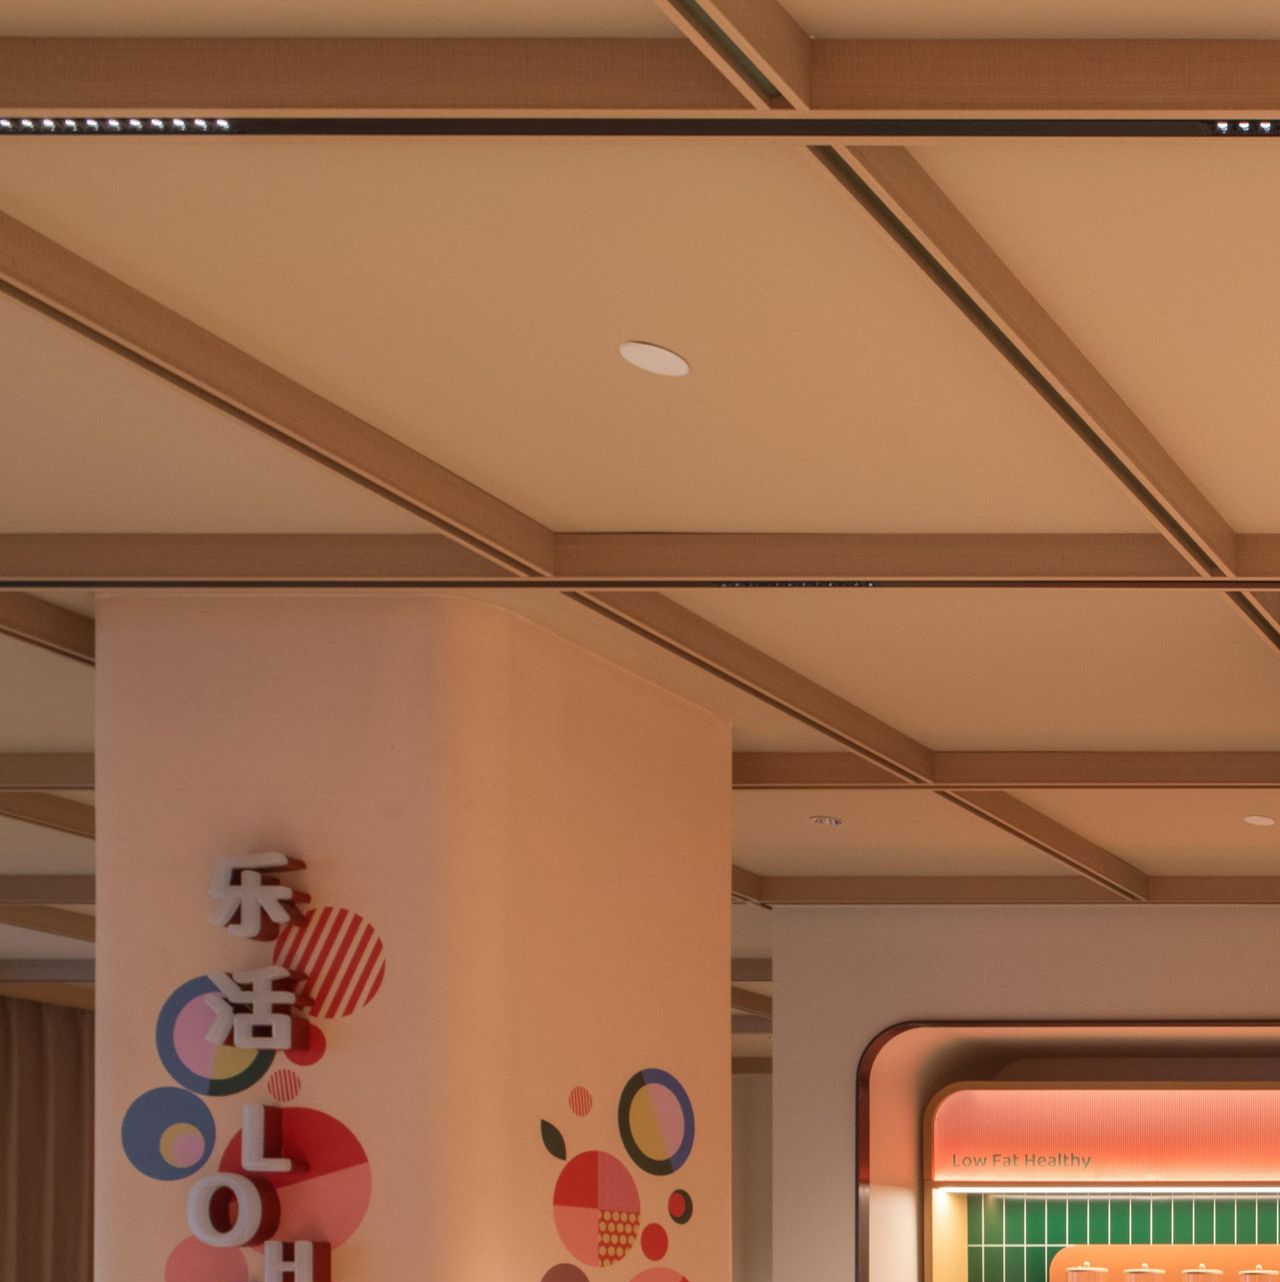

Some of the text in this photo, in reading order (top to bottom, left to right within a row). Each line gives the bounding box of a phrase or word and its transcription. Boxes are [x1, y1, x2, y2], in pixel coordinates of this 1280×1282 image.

[204, 852, 300, 1052] 乐活
[952, 1153, 1091, 1168] Low Fat Healthy
